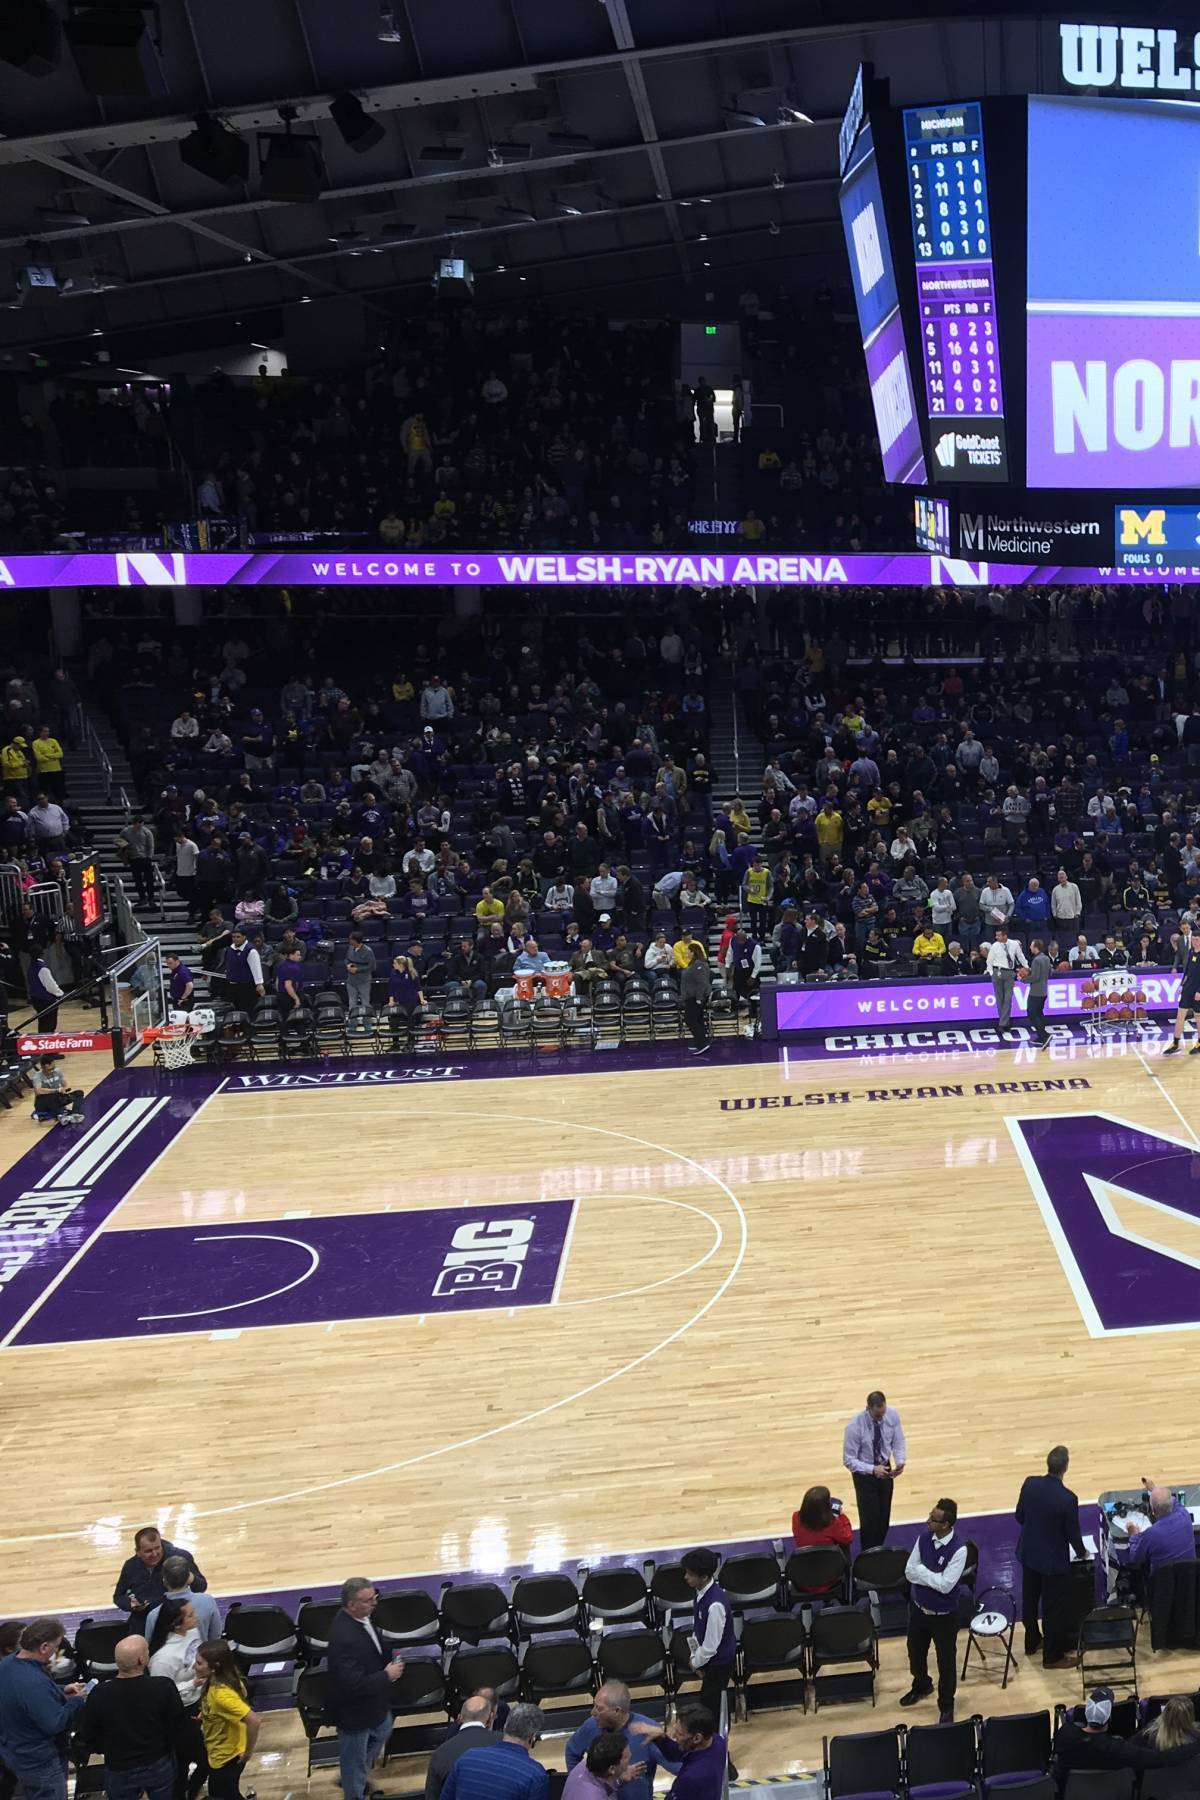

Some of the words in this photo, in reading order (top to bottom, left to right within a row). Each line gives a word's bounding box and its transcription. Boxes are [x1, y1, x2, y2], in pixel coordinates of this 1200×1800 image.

[921, 117, 964, 129] MICHIGAN
[931, 143, 948, 155] PTS
[972, 140, 978, 151] F
[912, 164, 919, 178] 1
[937, 162, 944, 176] 3
[956, 161, 963, 175] 1
[972, 159, 979, 173] 1
[914, 184, 922, 198] 2
[935, 182, 948, 196] 11
[958, 181, 964, 195] 1
[973, 180, 982, 193] 0
[916, 204, 923, 218] 3
[940, 202, 948, 216] 8
[959, 201, 967, 215] 3
[975, 200, 982, 213] 1
[918, 223, 926, 237] 4
[941, 222, 950, 236] 0
[960, 221, 968, 235] 3
[977, 219, 985, 233] 0
[919, 242, 932, 256] 13
[940, 241, 953, 255] 10
[962, 240, 969, 254] 1
[978, 239, 986, 253] 0
[922, 279, 989, 290] NORTHWESTERN
[944, 304, 961, 314] PTS
[984, 302, 990, 312] F
[926, 323, 934, 336] 4
[950, 322, 958, 336] 8
[968, 322, 976, 335] 2
[985, 321, 992, 335] 3
[928, 342, 935, 356] 5
[948, 342, 962, 355] 16
[970, 341, 978, 355] 4
[986, 341, 994, 354] 0
[929, 361, 941, 374] 11
[953, 361, 961, 374] 0
[971, 360, 979, 373] 3
[987, 360, 994, 373] 1
[930, 379, 944, 393] 14
[954, 379, 962, 392] 4
[972, 379, 981, 392] 0
[989, 379, 996, 392] 2
[932, 398, 944, 411] 21
[956, 398, 964, 411] 0
[974, 398, 982, 411] 2
[990, 398, 998, 411] 0
[967, 451, 1000, 465] TICKETS
[988, 515, 1100, 535] Northwestern
[1120, 510, 1166, 545] M
[988, 534, 1051, 554] Medicine
[1123, 553, 1150, 564] FOULS
[1156, 553, 1163, 565] 0
[116, 553, 186, 585] N
[312, 562, 437, 577] WELCOME
[450, 562, 481, 577] TO
[498, 556, 725, 583] WELSH-RYAN
[731, 556, 848, 583] ARENA
[857, 994, 960, 1013] WELCOME
[972, 994, 996, 1007] TO
[237, 1066, 465, 1087] WINTRUST
[718, 1085, 964, 1111] WELSH-RYAN
[972, 1077, 1093, 1096] ARENA
[981, 1614, 998, 1626] N
